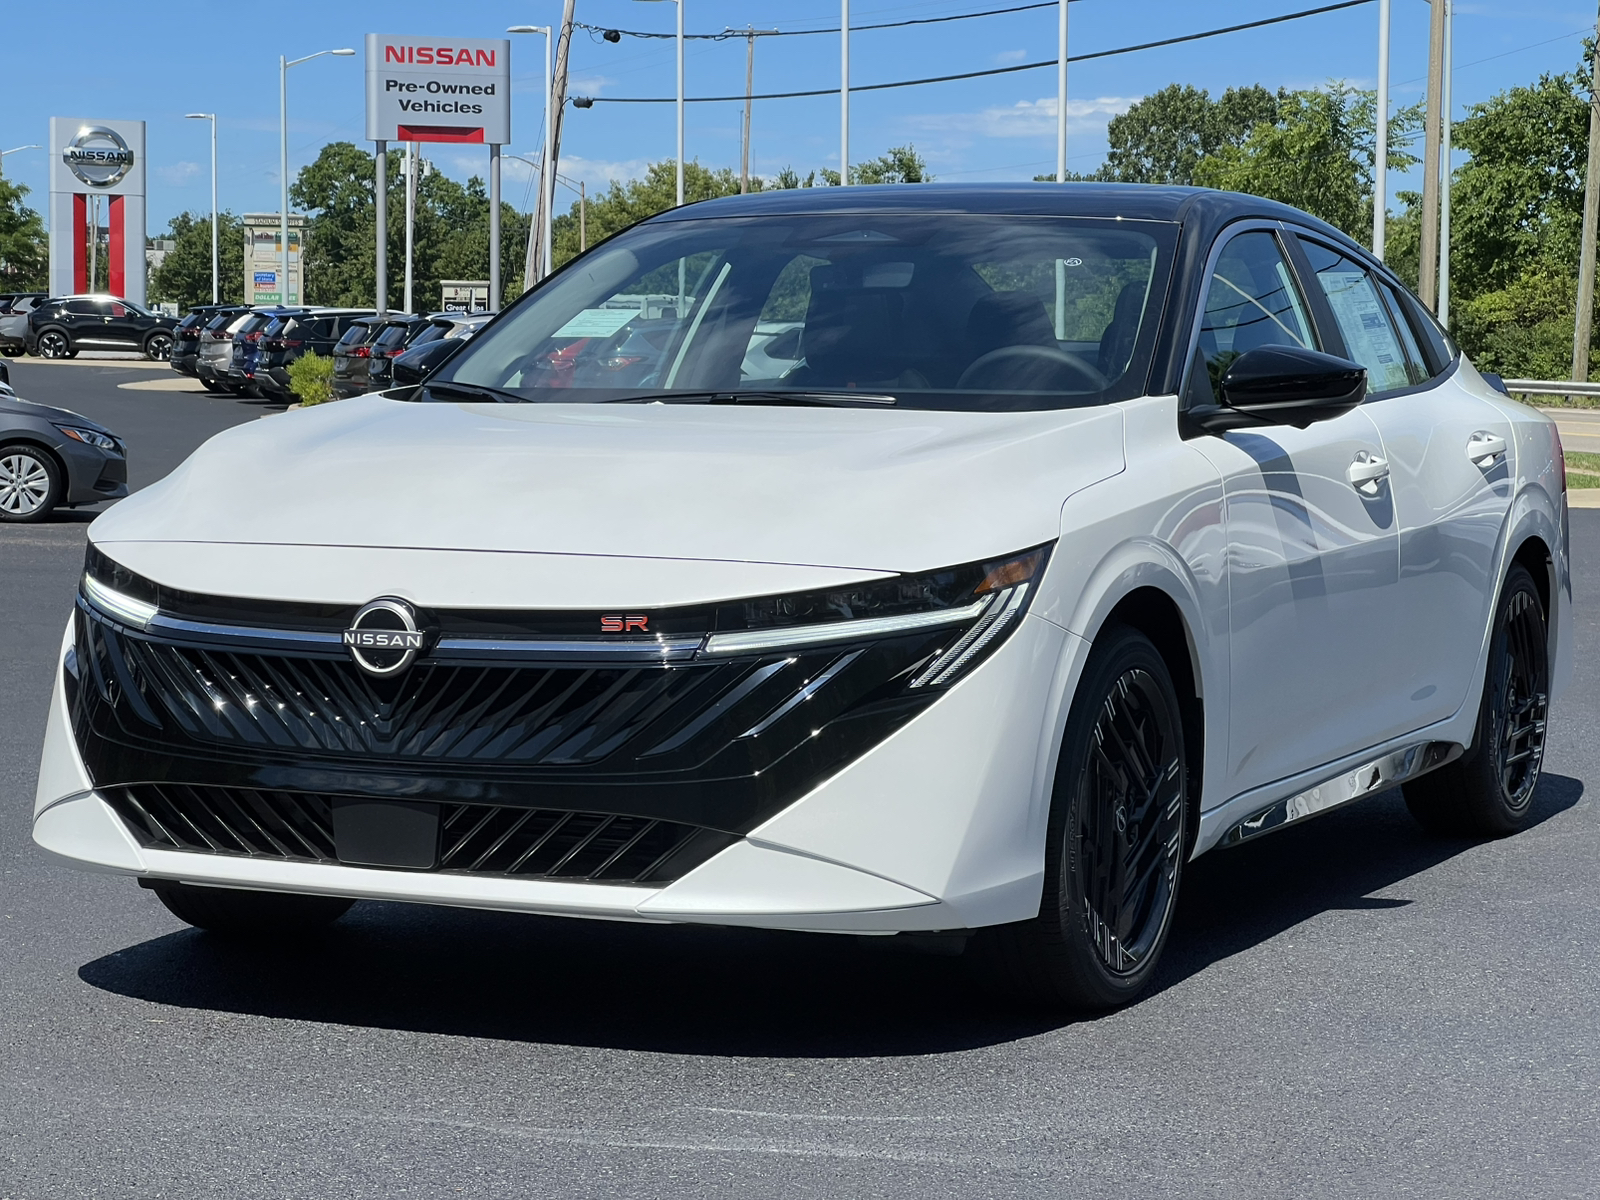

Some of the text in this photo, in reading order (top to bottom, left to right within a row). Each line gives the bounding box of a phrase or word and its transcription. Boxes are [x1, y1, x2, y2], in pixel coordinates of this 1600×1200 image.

[385, 45, 496, 67] NISSAN
[385, 79, 496, 96] Pre-Owned
[398, 98, 483, 114] Vehicles
[70, 150, 127, 161] NISSAN
[601, 614, 650, 632] SR
[343, 632, 422, 648] NISSAN
